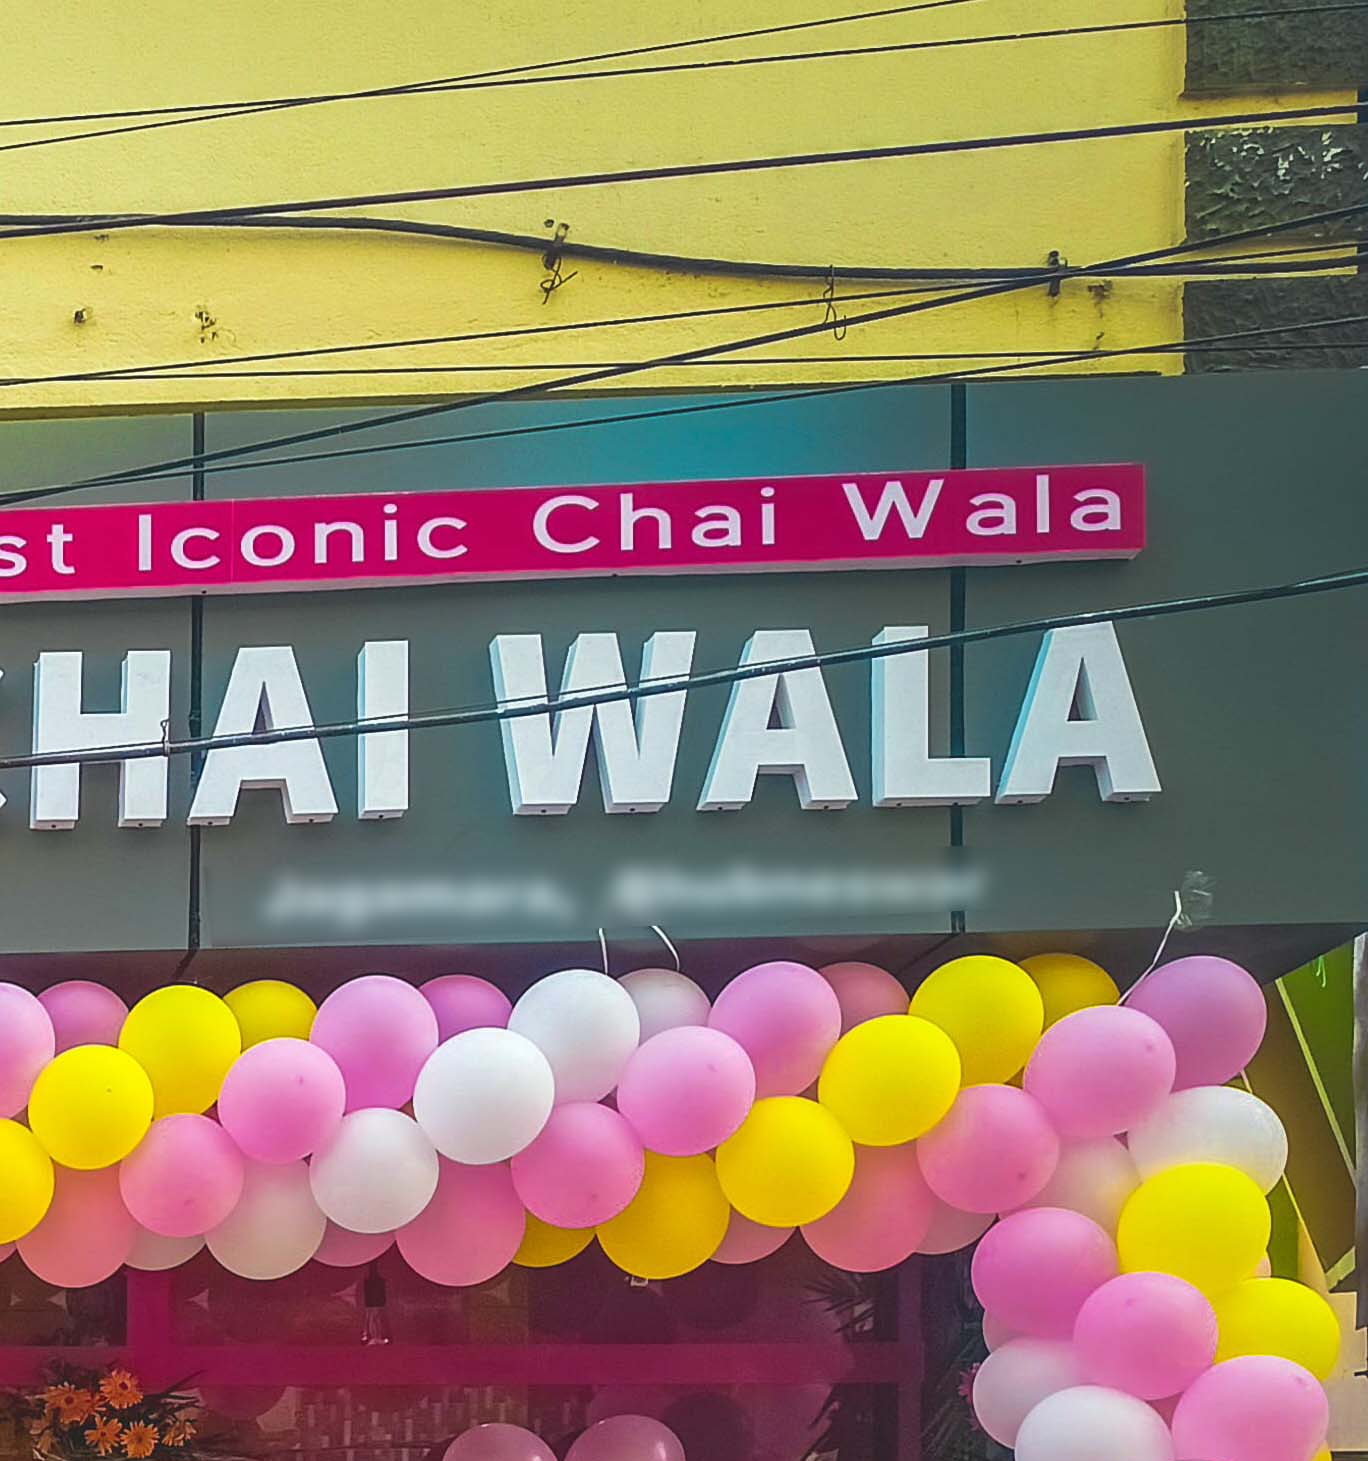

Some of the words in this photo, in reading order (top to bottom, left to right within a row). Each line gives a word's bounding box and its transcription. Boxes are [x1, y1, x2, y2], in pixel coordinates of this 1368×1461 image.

[137, 502, 470, 573] Iconic
[531, 485, 778, 555] Chai
[841, 473, 1125, 542] Wala
[489, 620, 1163, 816] WALA
